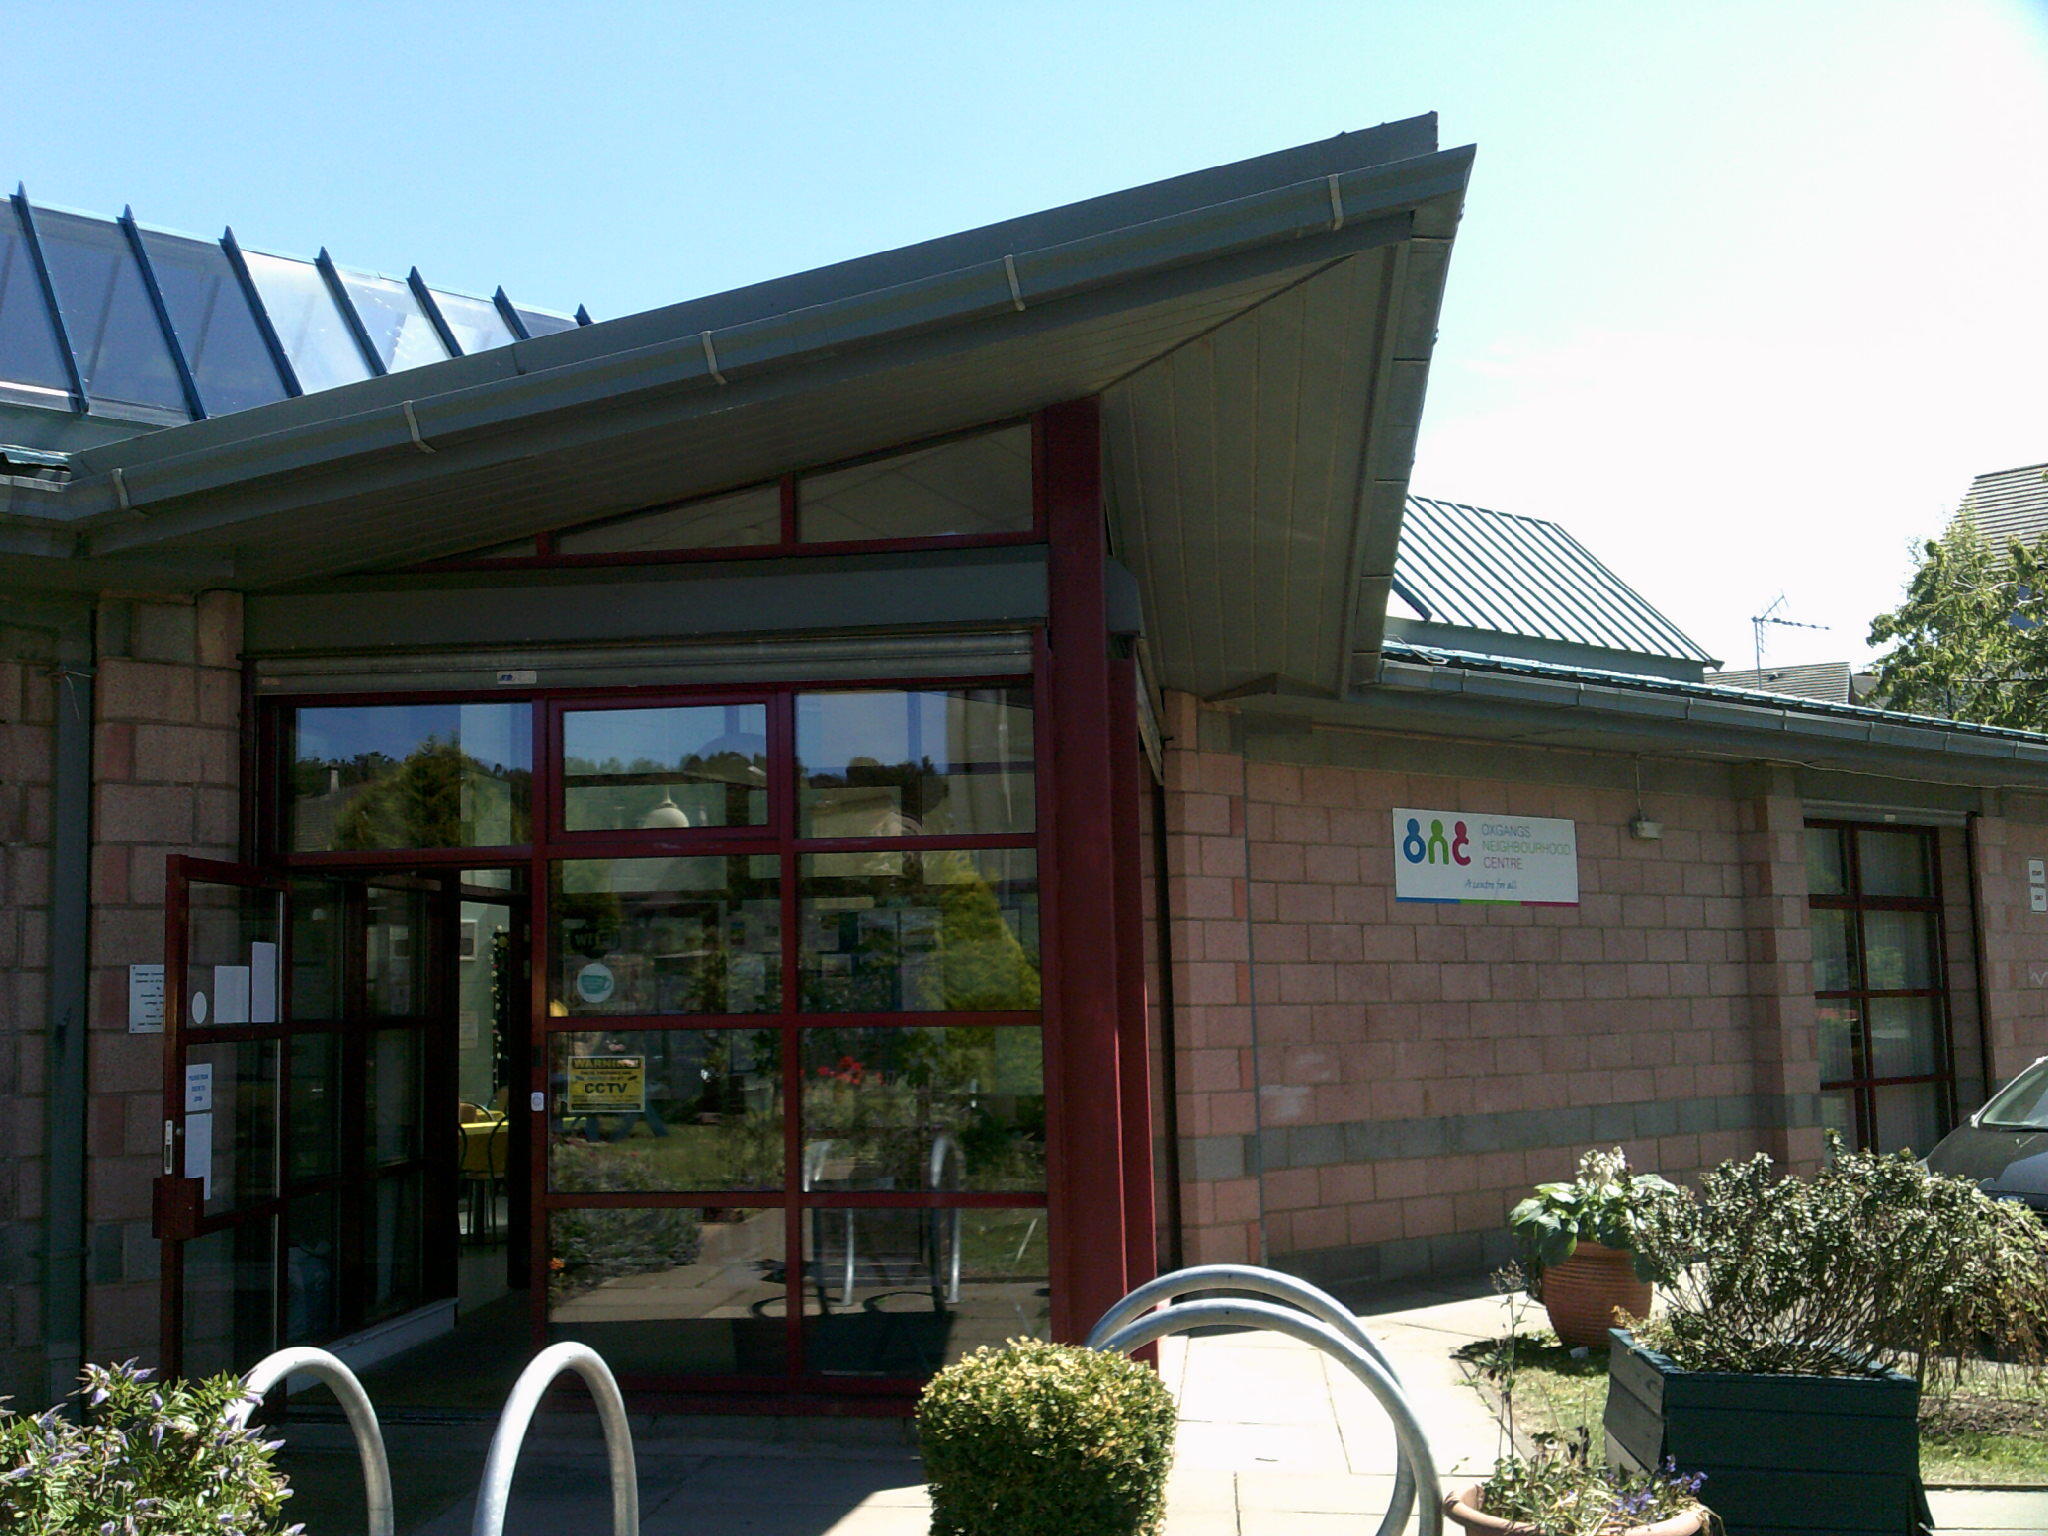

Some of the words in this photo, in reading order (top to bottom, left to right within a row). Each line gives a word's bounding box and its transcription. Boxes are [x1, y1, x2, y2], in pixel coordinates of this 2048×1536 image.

[1481, 823, 1531, 839] OXGANGS
[1481, 840, 1571, 856] NEIGHBOURHOOD
[1483, 856, 1523, 870] CENTRE
[584, 1083, 627, 1094] CCTV
